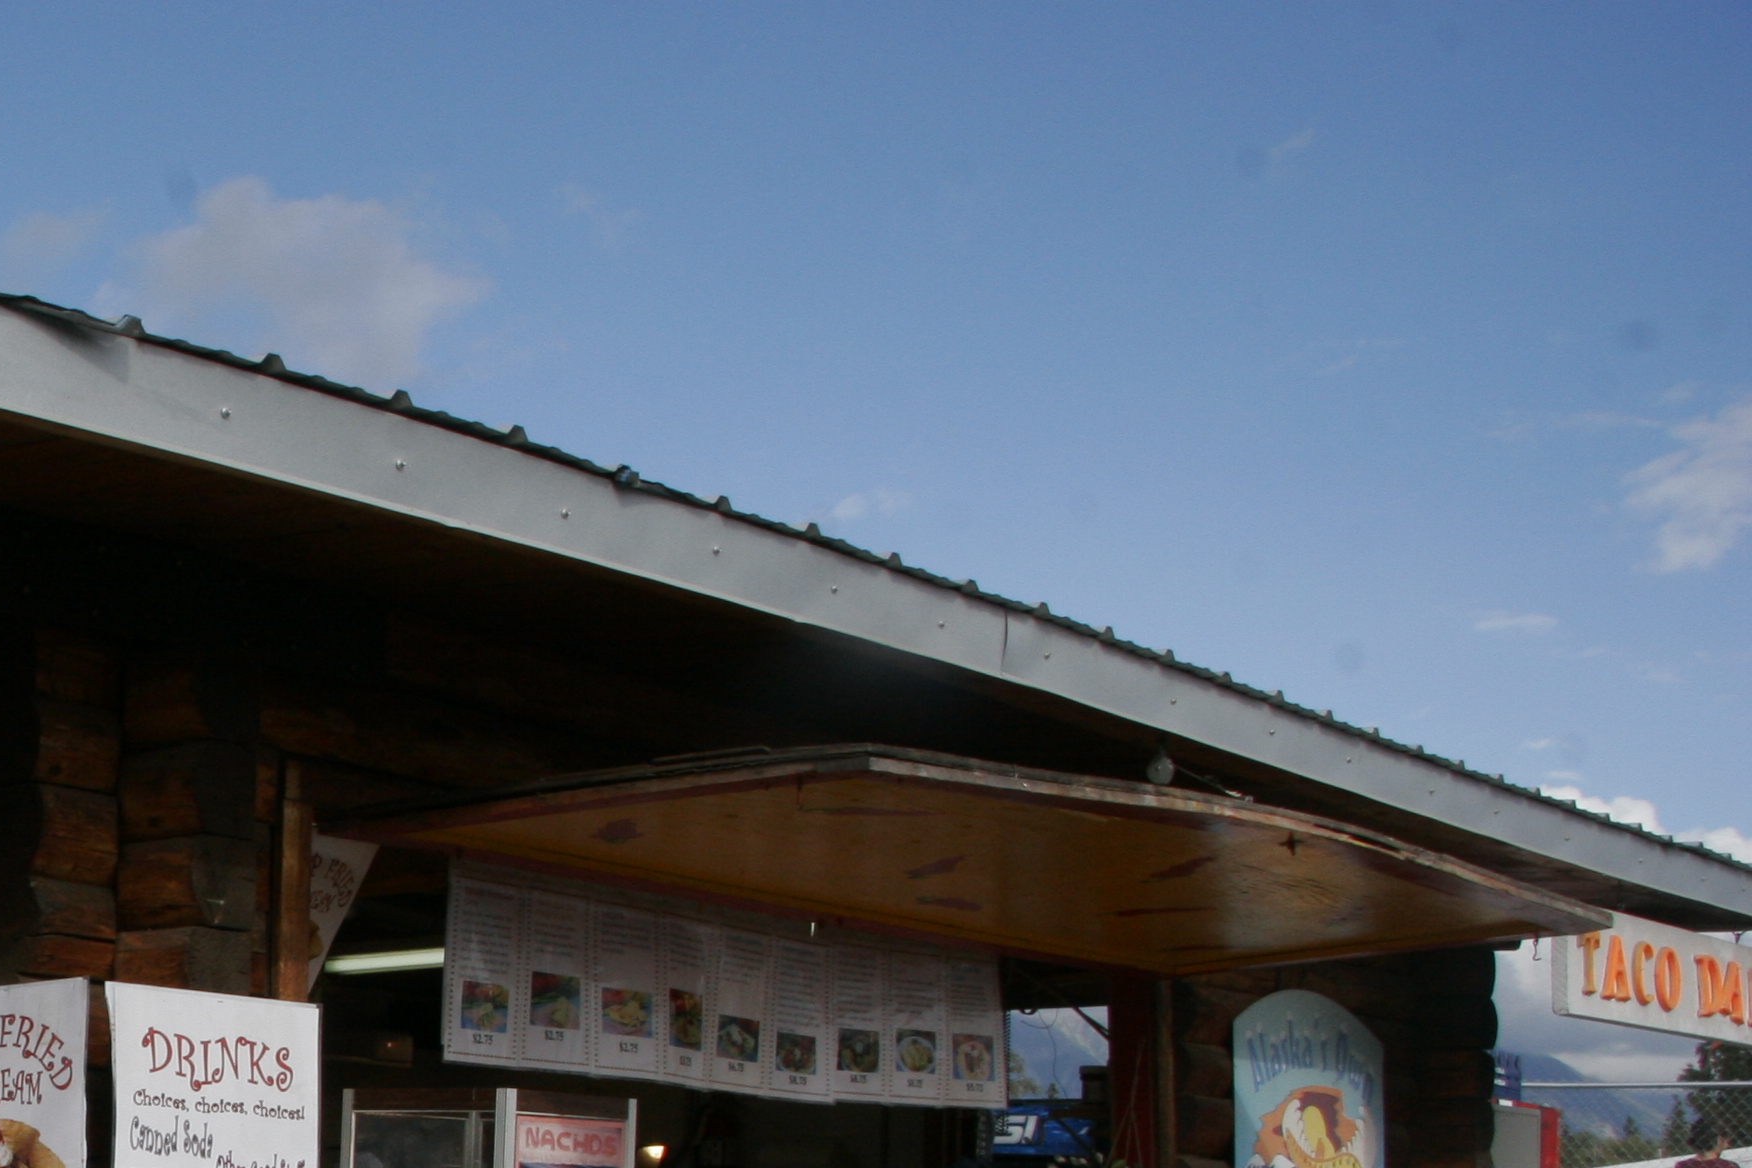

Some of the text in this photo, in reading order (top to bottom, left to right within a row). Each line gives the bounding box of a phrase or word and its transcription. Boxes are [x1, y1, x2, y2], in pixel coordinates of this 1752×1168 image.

[1576, 930, 1752, 1028] TACO DA
[472, 1032, 494, 1046] $2.75
[544, 1030, 564, 1042] $2.75
[1246, 1017, 1329, 1093] Alaska's
[141, 1026, 294, 1092] DRINKS
[132, 1088, 306, 1121] Choices, choices, choices!
[129, 1114, 213, 1160] Canned Soda
[524, 1126, 618, 1158] NACHOS
